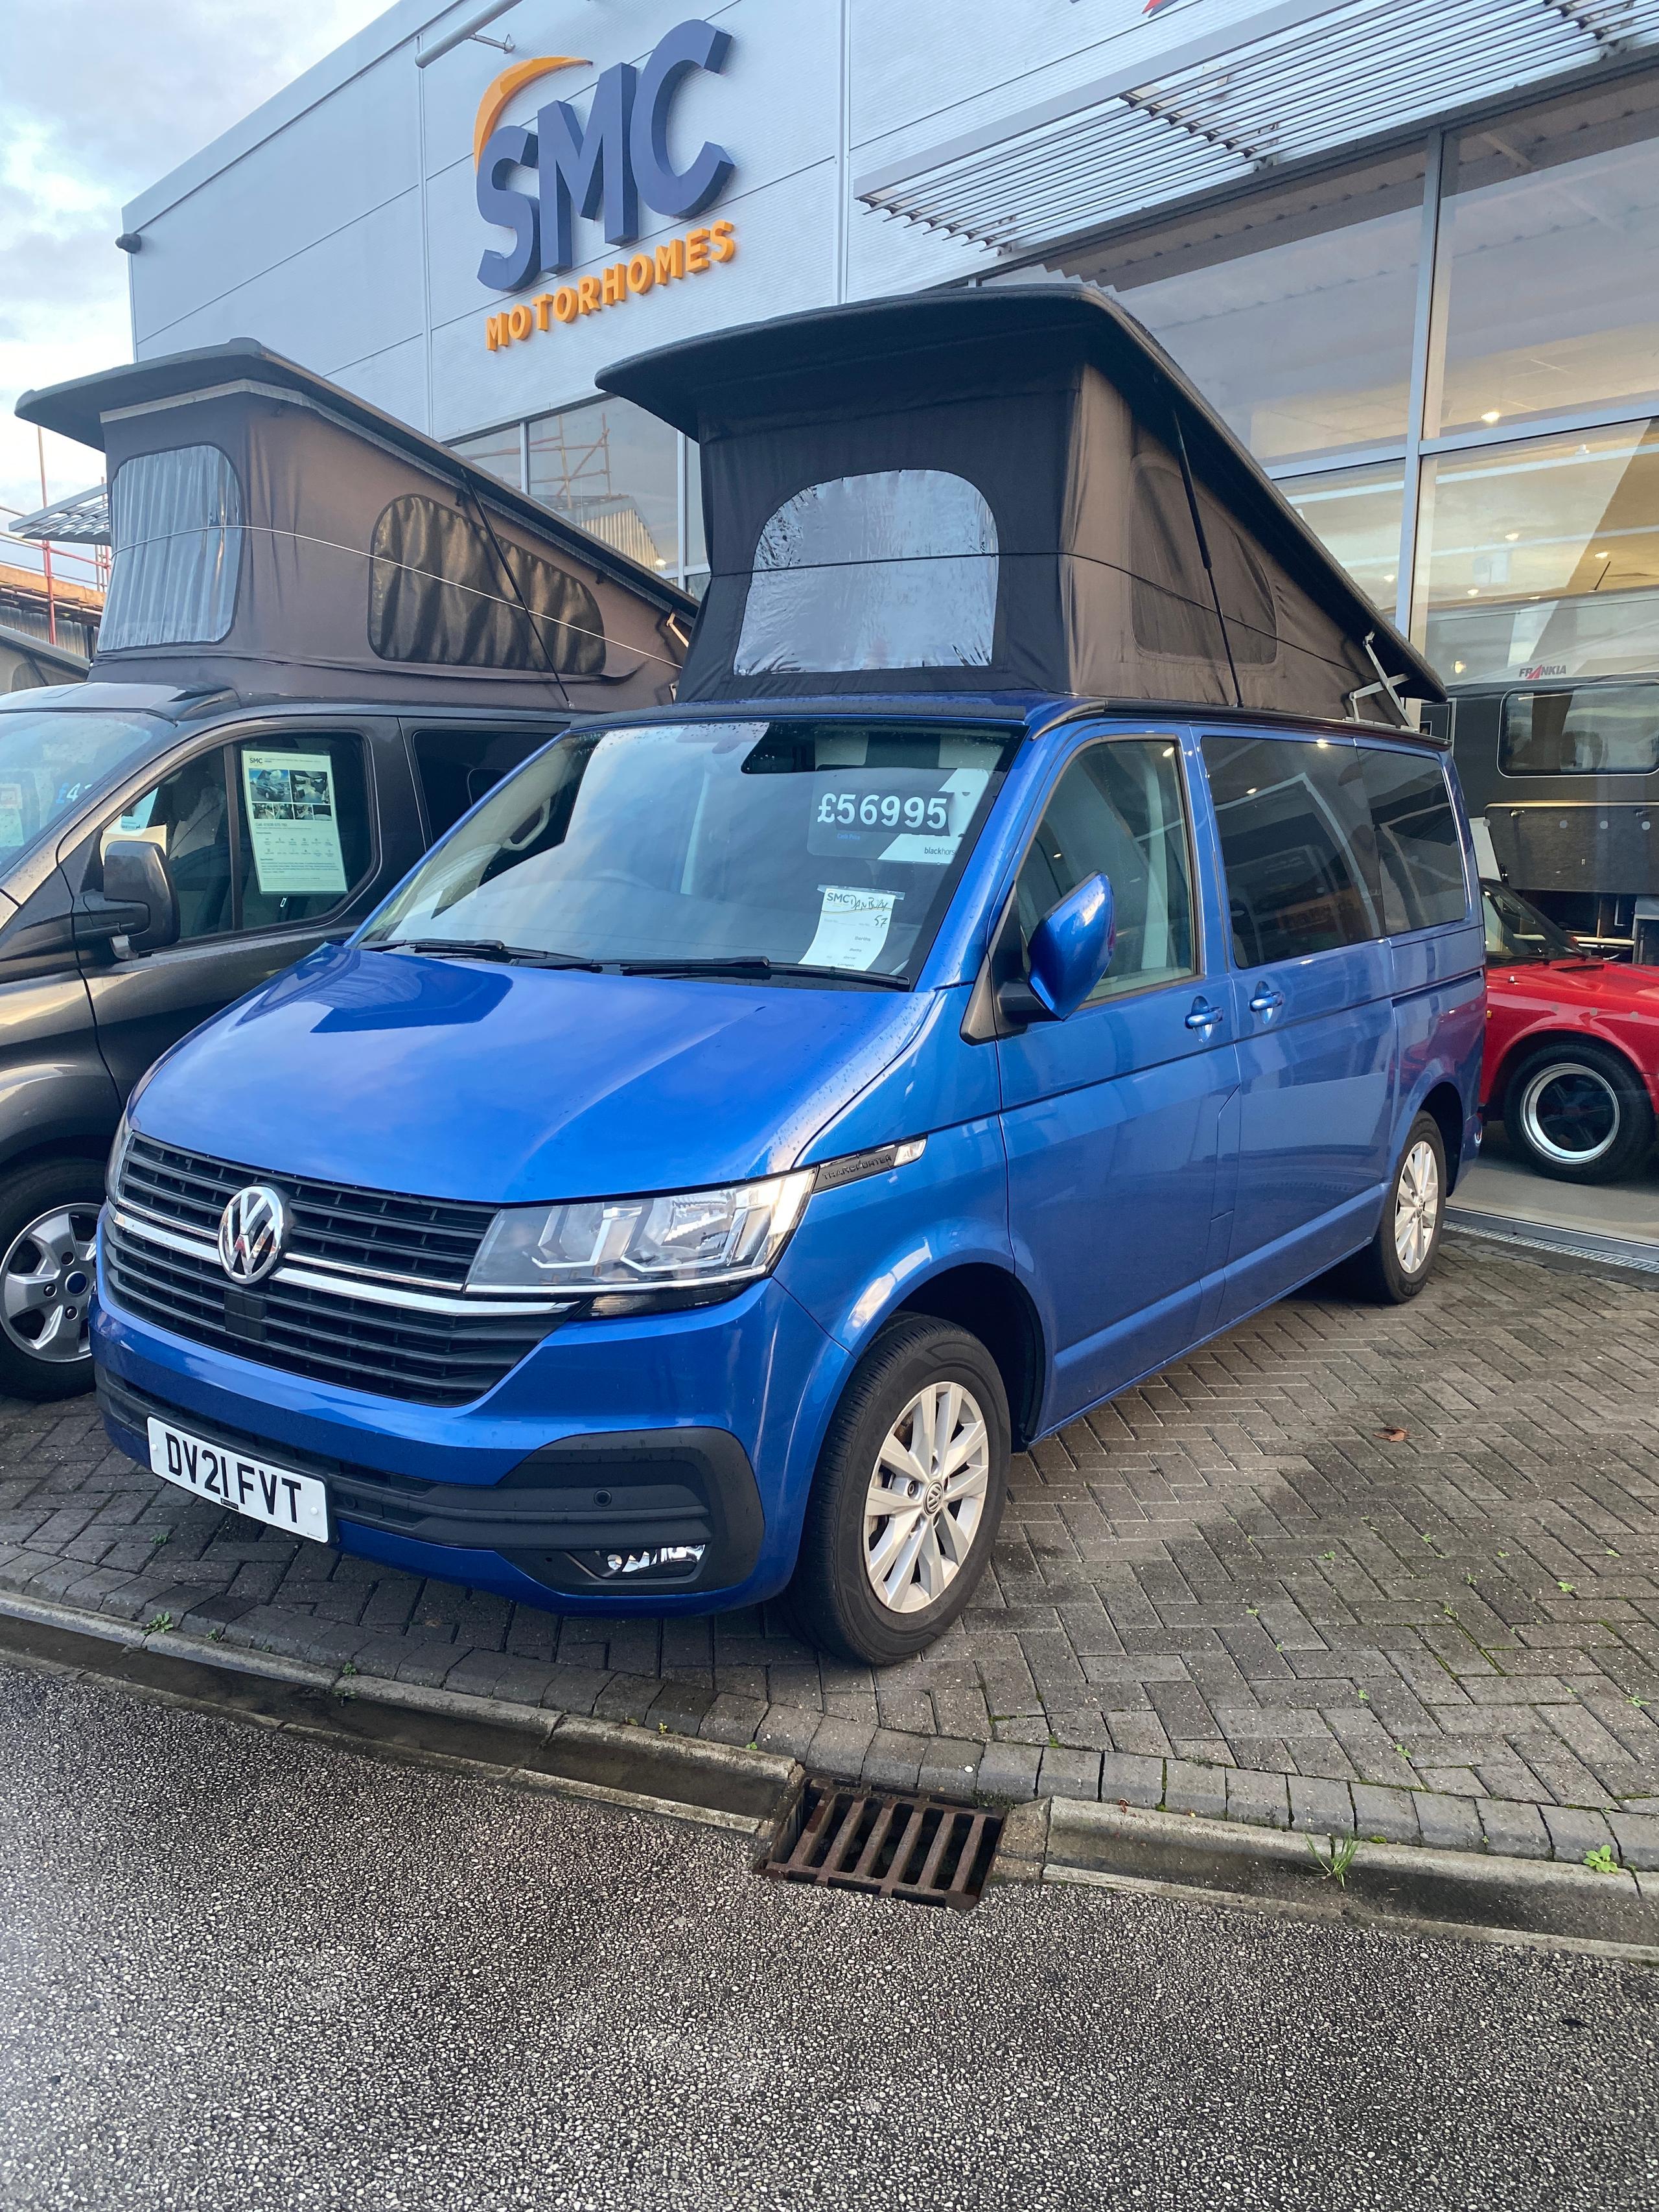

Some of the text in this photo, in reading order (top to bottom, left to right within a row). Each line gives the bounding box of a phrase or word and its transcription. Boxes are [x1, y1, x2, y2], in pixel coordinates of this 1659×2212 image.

[476, 19, 735, 292] SMC
[485, 220, 735, 352] MOTORHOMES
[1518, 664, 1566, 680] FRANKIA
[817, 793, 947, 830] £56995
[827, 892, 850, 903] SMC
[823, 1154, 892, 1180] TRANSPORTER
